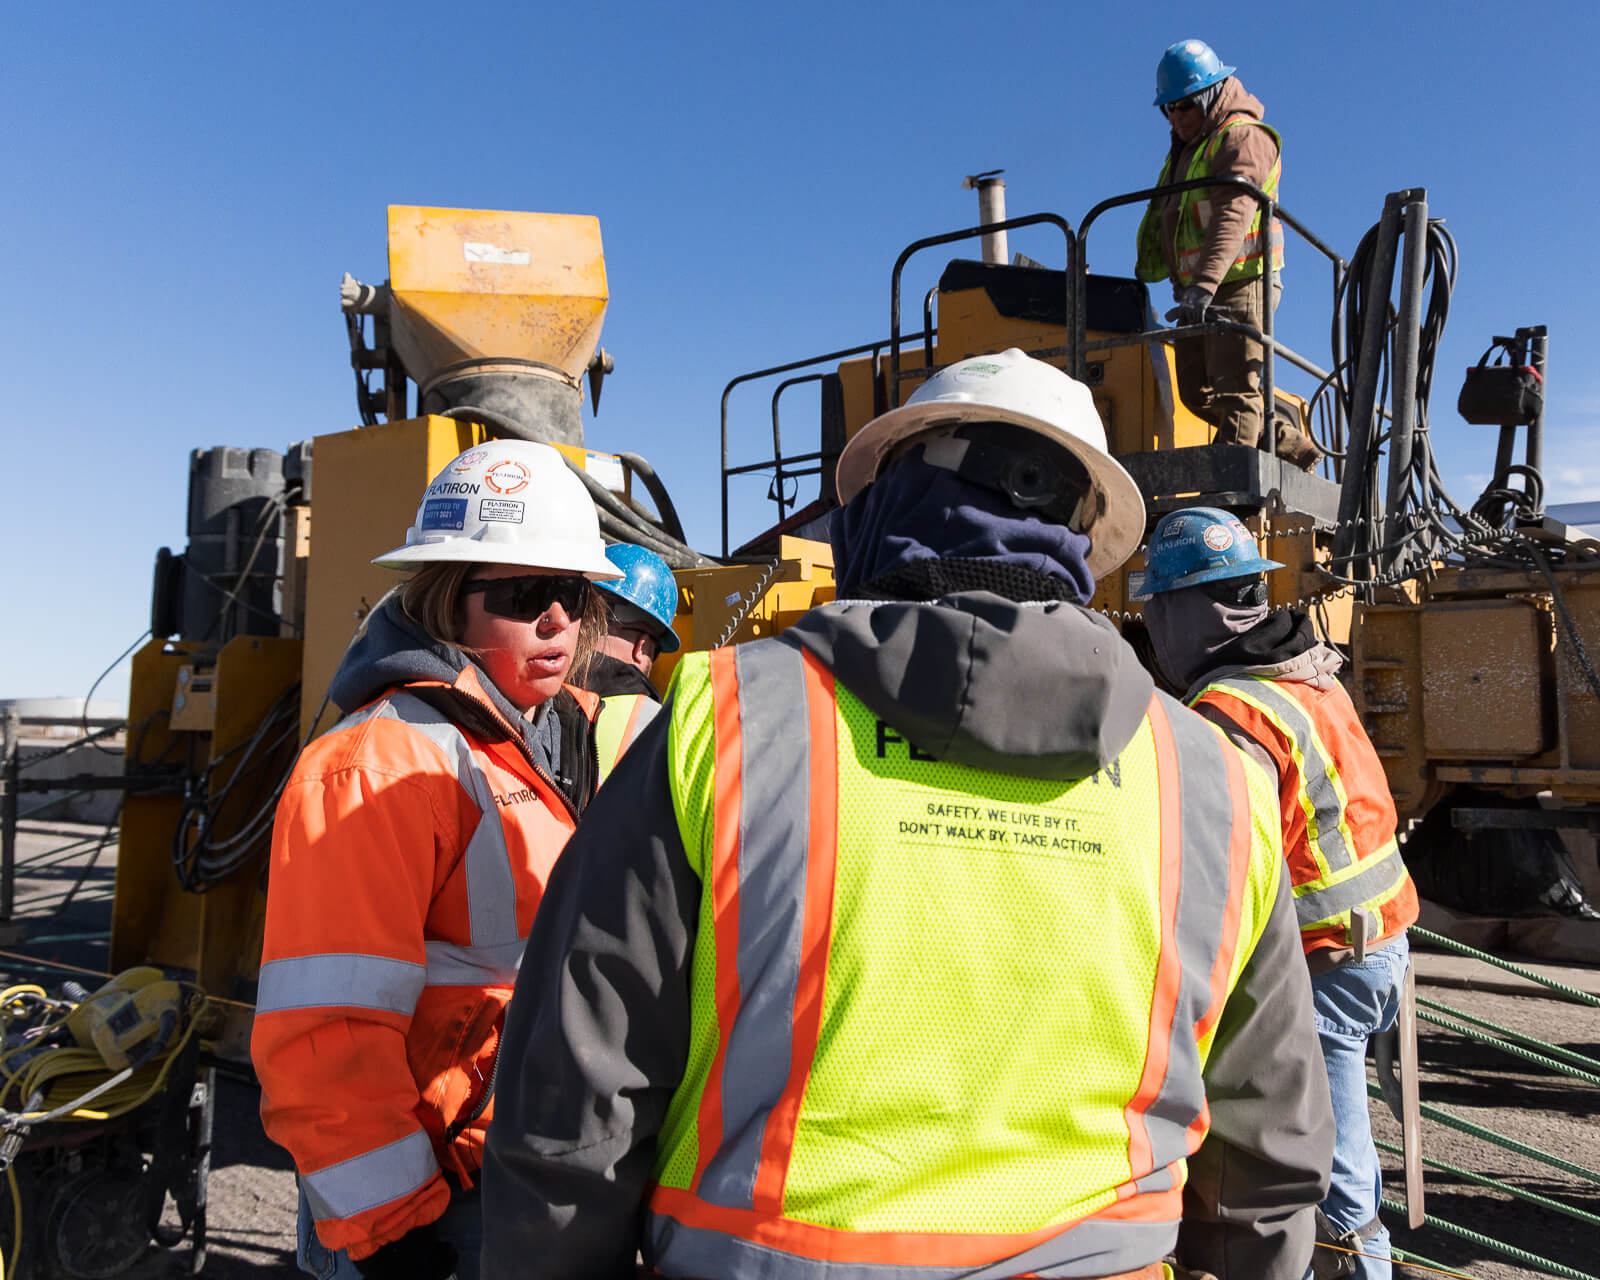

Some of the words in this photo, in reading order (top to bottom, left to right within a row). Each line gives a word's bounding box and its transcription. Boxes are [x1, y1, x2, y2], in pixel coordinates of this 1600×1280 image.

[428, 482, 480, 496] FLATIRON
[494, 789, 538, 807] FLTIRO
[927, 803, 982, 820] SAFETY.
[988, 808, 1007, 823] WE
[1011, 812, 1040, 827] LIVE
[1045, 816, 1060, 829] BY
[1065, 818, 1080, 832] IT.
[899, 821, 942, 836] DON'T
[946, 825, 985, 840] WALK
[989, 829, 1008, 843] BY.
[1014, 832, 1047, 847] TAKE
[1052, 837, 1106, 856] ACTION.
